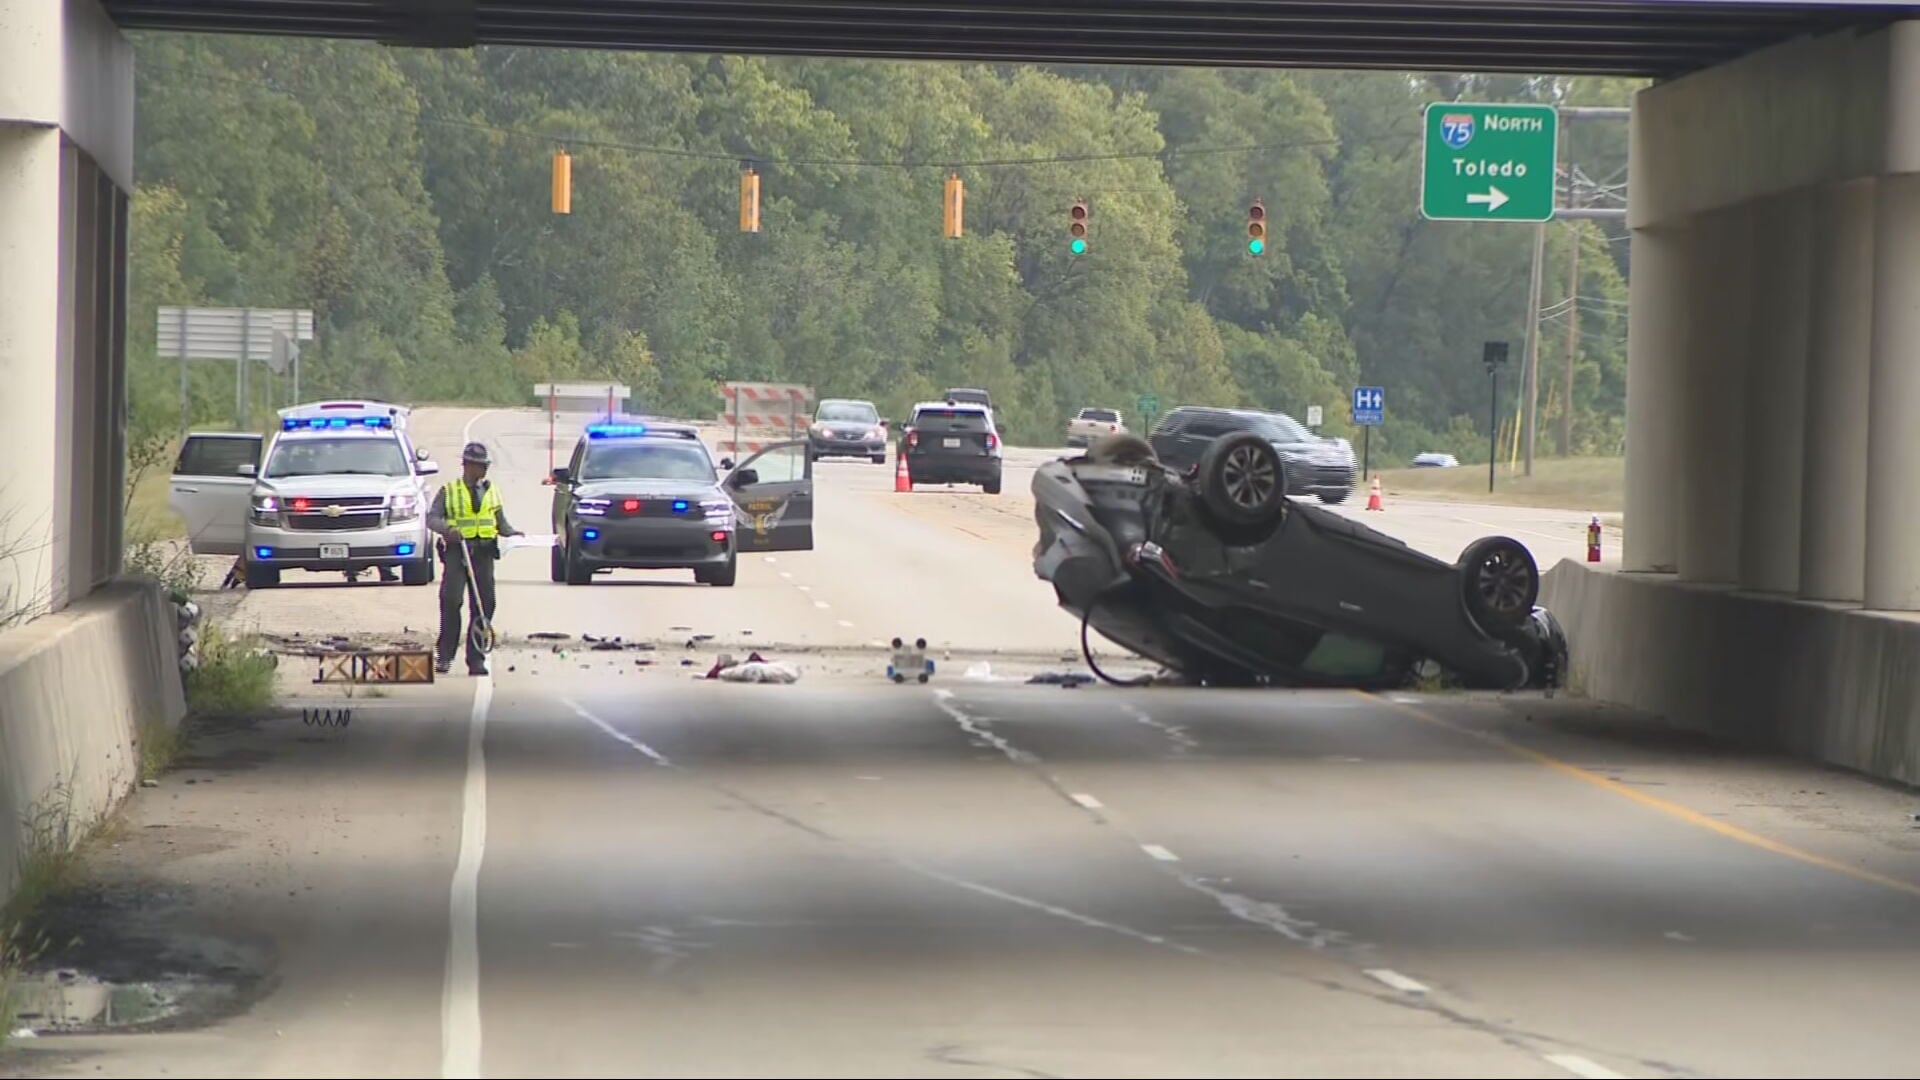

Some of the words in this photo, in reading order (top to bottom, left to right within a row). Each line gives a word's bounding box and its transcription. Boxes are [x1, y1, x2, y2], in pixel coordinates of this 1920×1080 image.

[1444, 122, 1470, 142] 75
[1484, 114, 1543, 131] NORTH
[1452, 158, 1527, 177] Toledo
[1357, 390, 1371, 408] H
